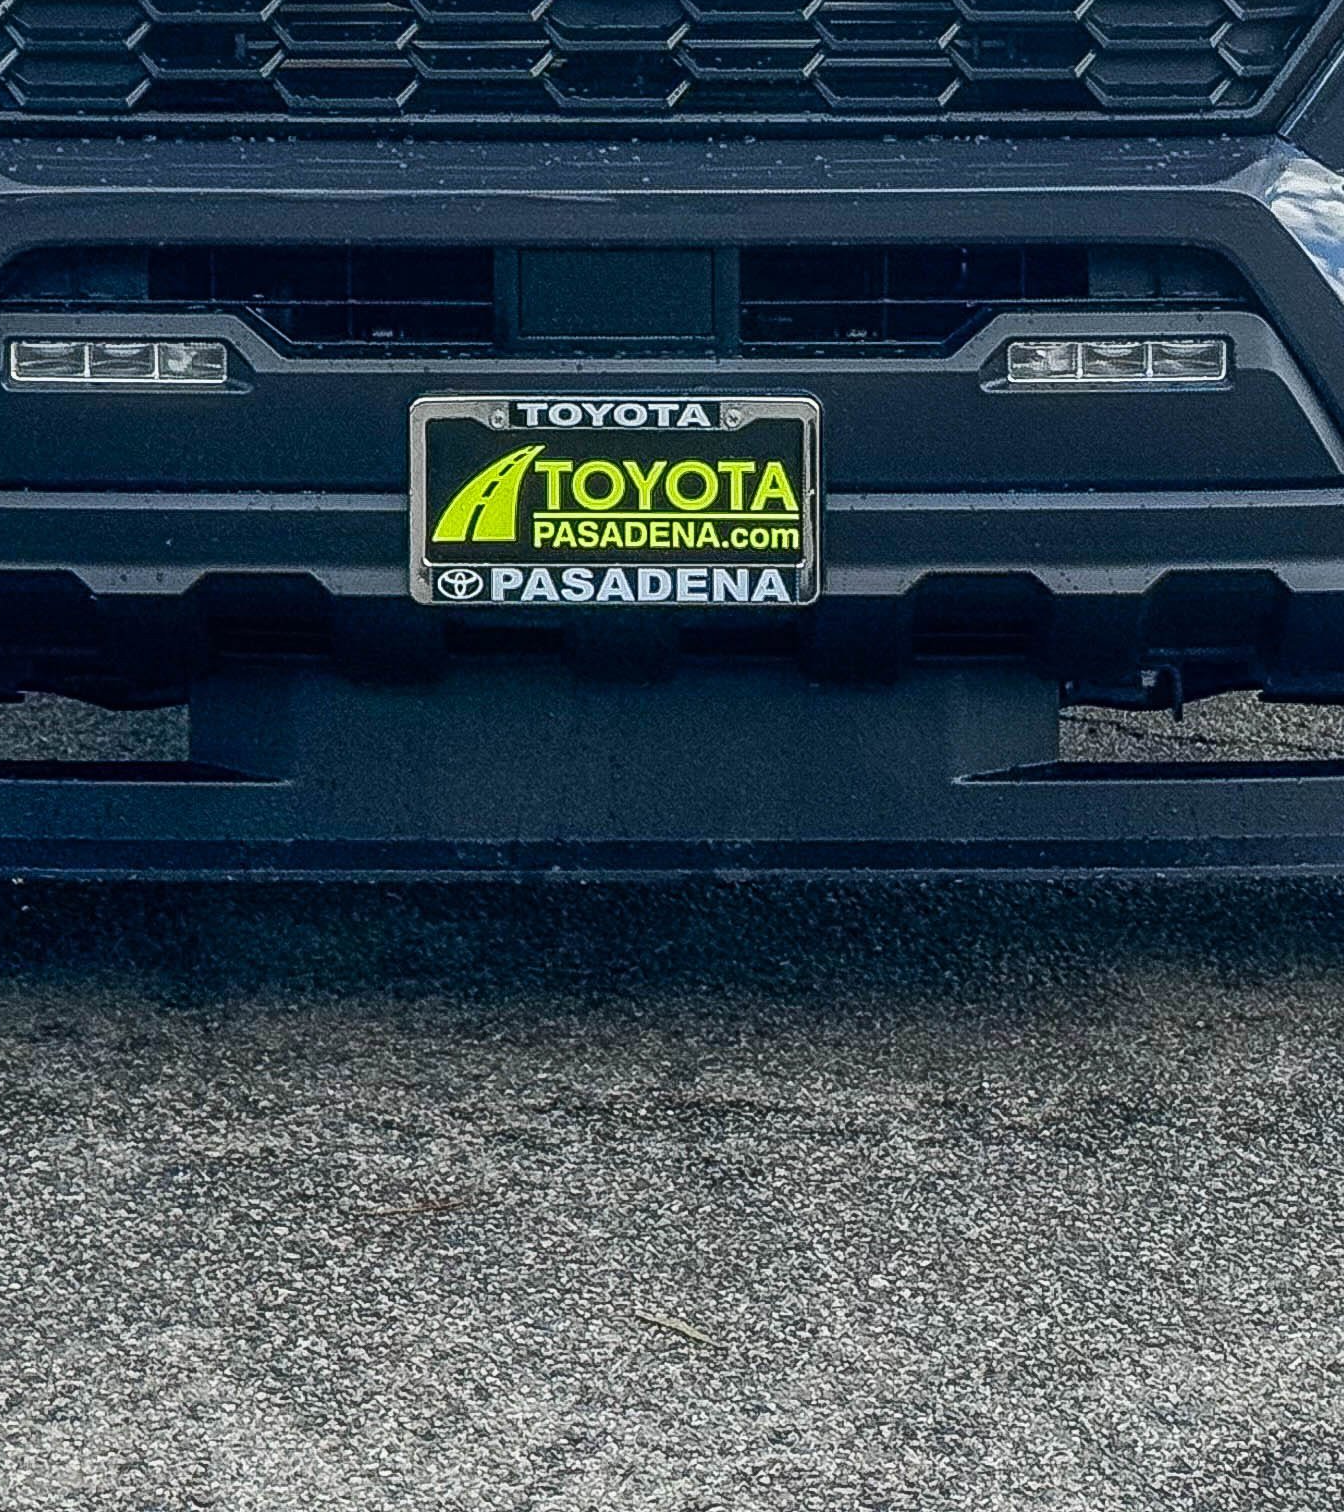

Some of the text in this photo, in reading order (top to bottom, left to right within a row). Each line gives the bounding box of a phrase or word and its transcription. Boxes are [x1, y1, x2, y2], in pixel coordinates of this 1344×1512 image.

[517, 402, 711, 428] TOYOTA
[533, 461, 799, 512] TOYOTA
[533, 521, 800, 549] PASADENA.com
[490, 567, 792, 602] PASADENA
